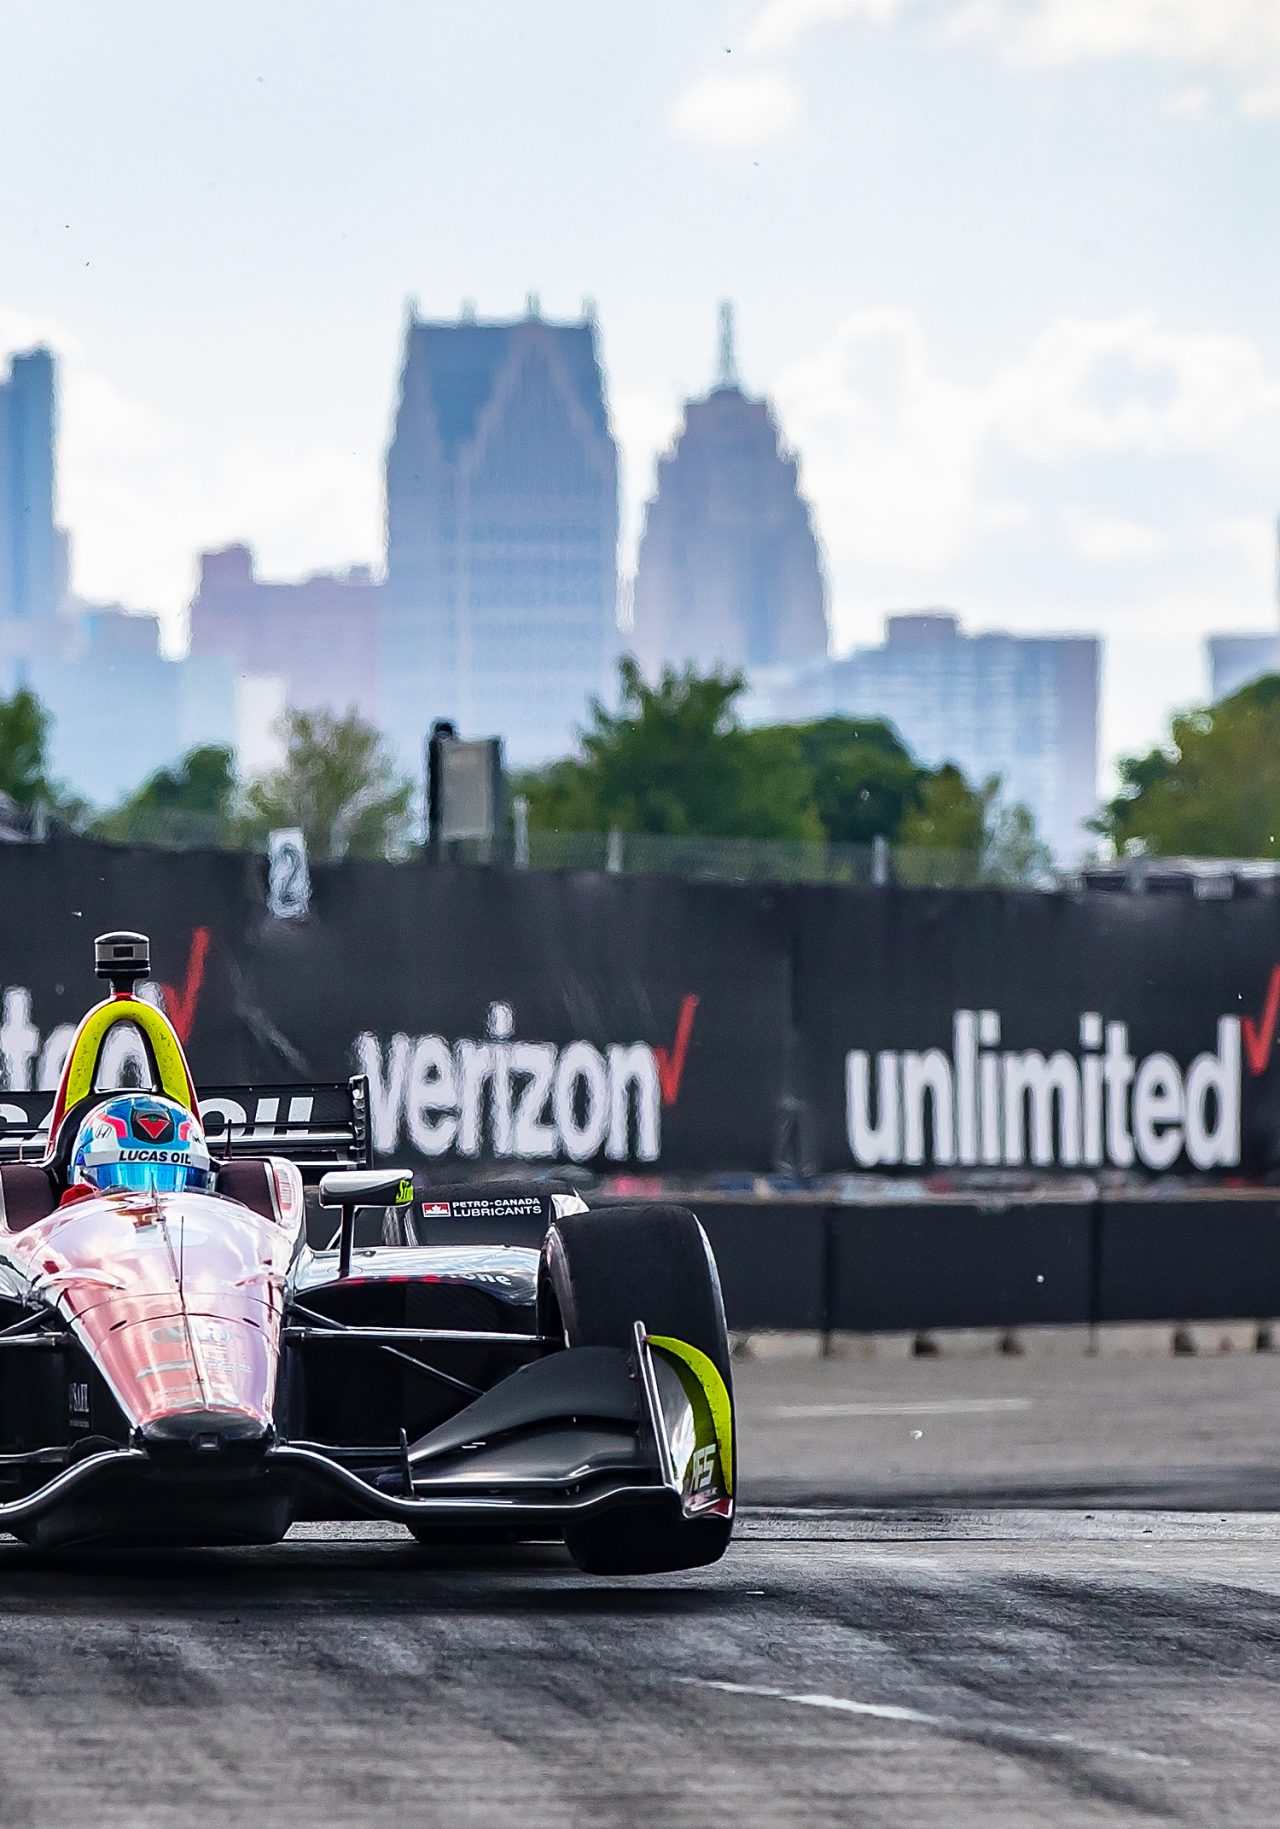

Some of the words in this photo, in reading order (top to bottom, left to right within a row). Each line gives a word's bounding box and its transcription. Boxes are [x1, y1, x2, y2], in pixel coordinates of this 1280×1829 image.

[275, 842, 300, 907] 2
[352, 1000, 662, 1162] verizon
[845, 1009, 1242, 1171] unlimited
[119, 1150, 168, 1162] LUCAS
[171, 1152, 191, 1164] OIL
[452, 1198, 540, 1209] PETRO-CANADA
[453, 1205, 542, 1217] LUBRICANTS
